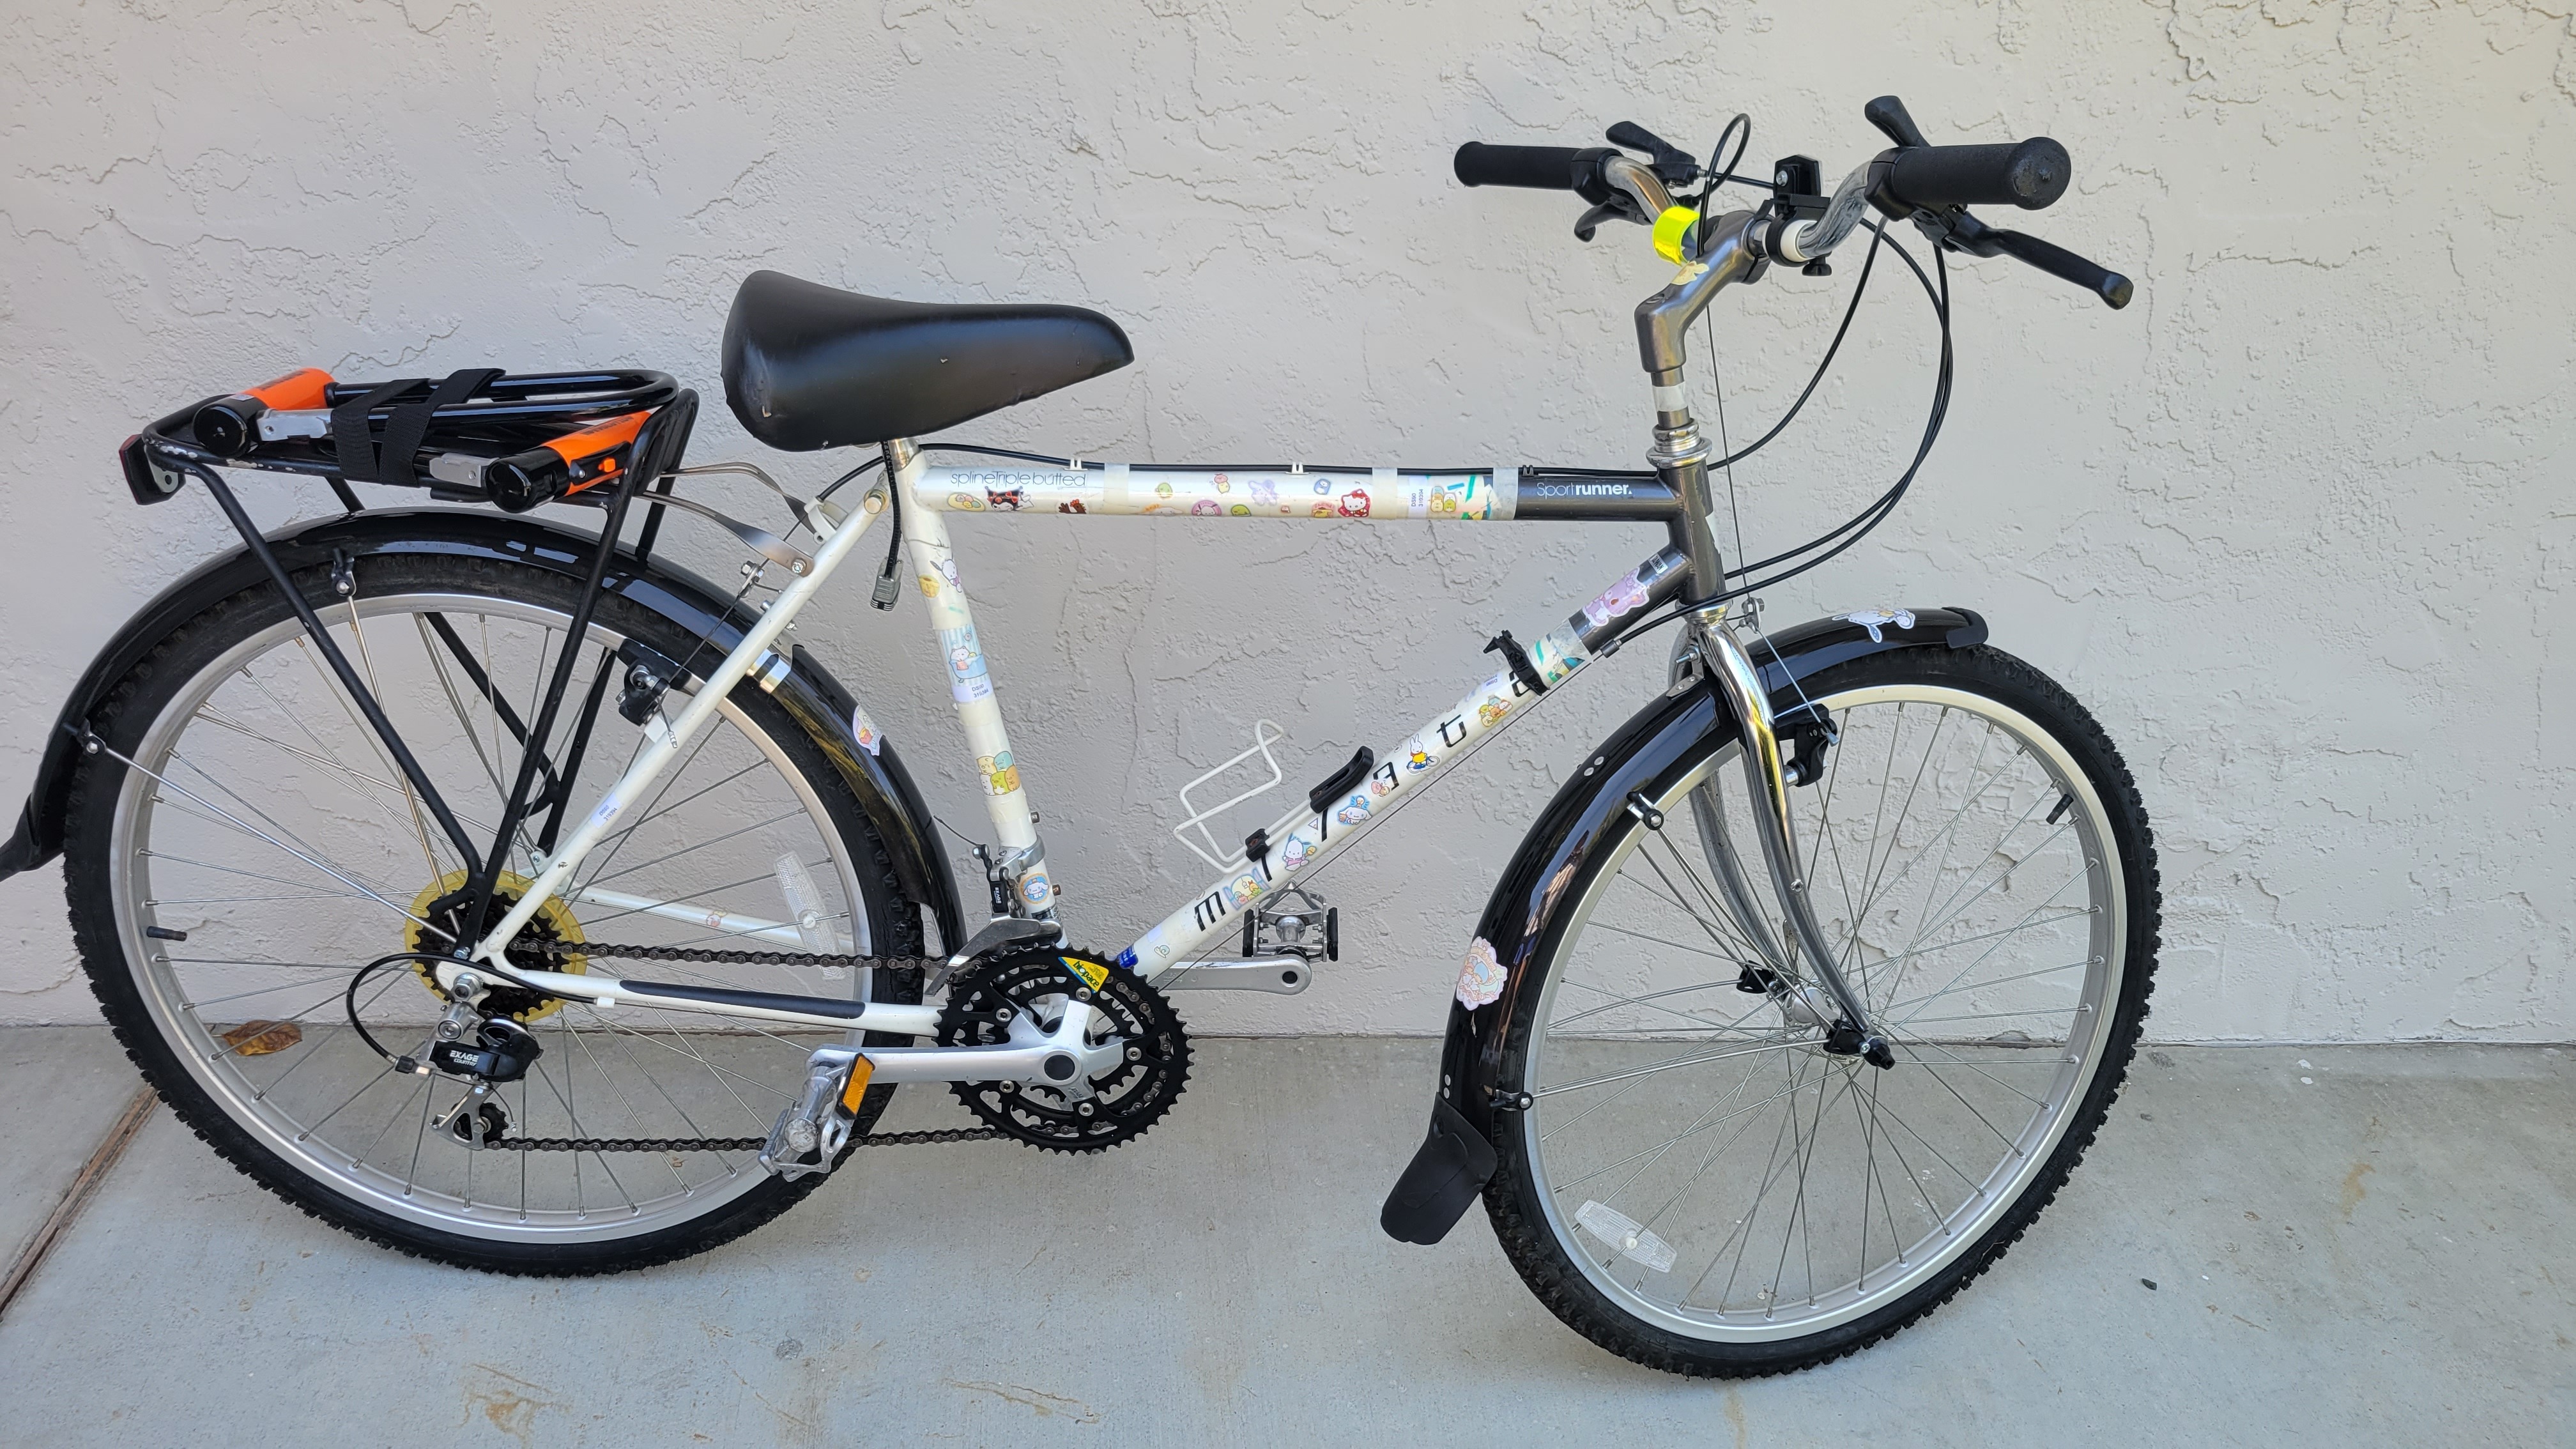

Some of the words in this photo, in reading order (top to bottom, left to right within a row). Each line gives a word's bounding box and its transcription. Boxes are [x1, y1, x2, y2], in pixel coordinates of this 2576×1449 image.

[1032, 472, 1085, 486] butted
[1073, 961, 1099, 988] biopace
[449, 1050, 479, 1062] EXAGE
[454, 1058, 477, 1067] COUNTRY
